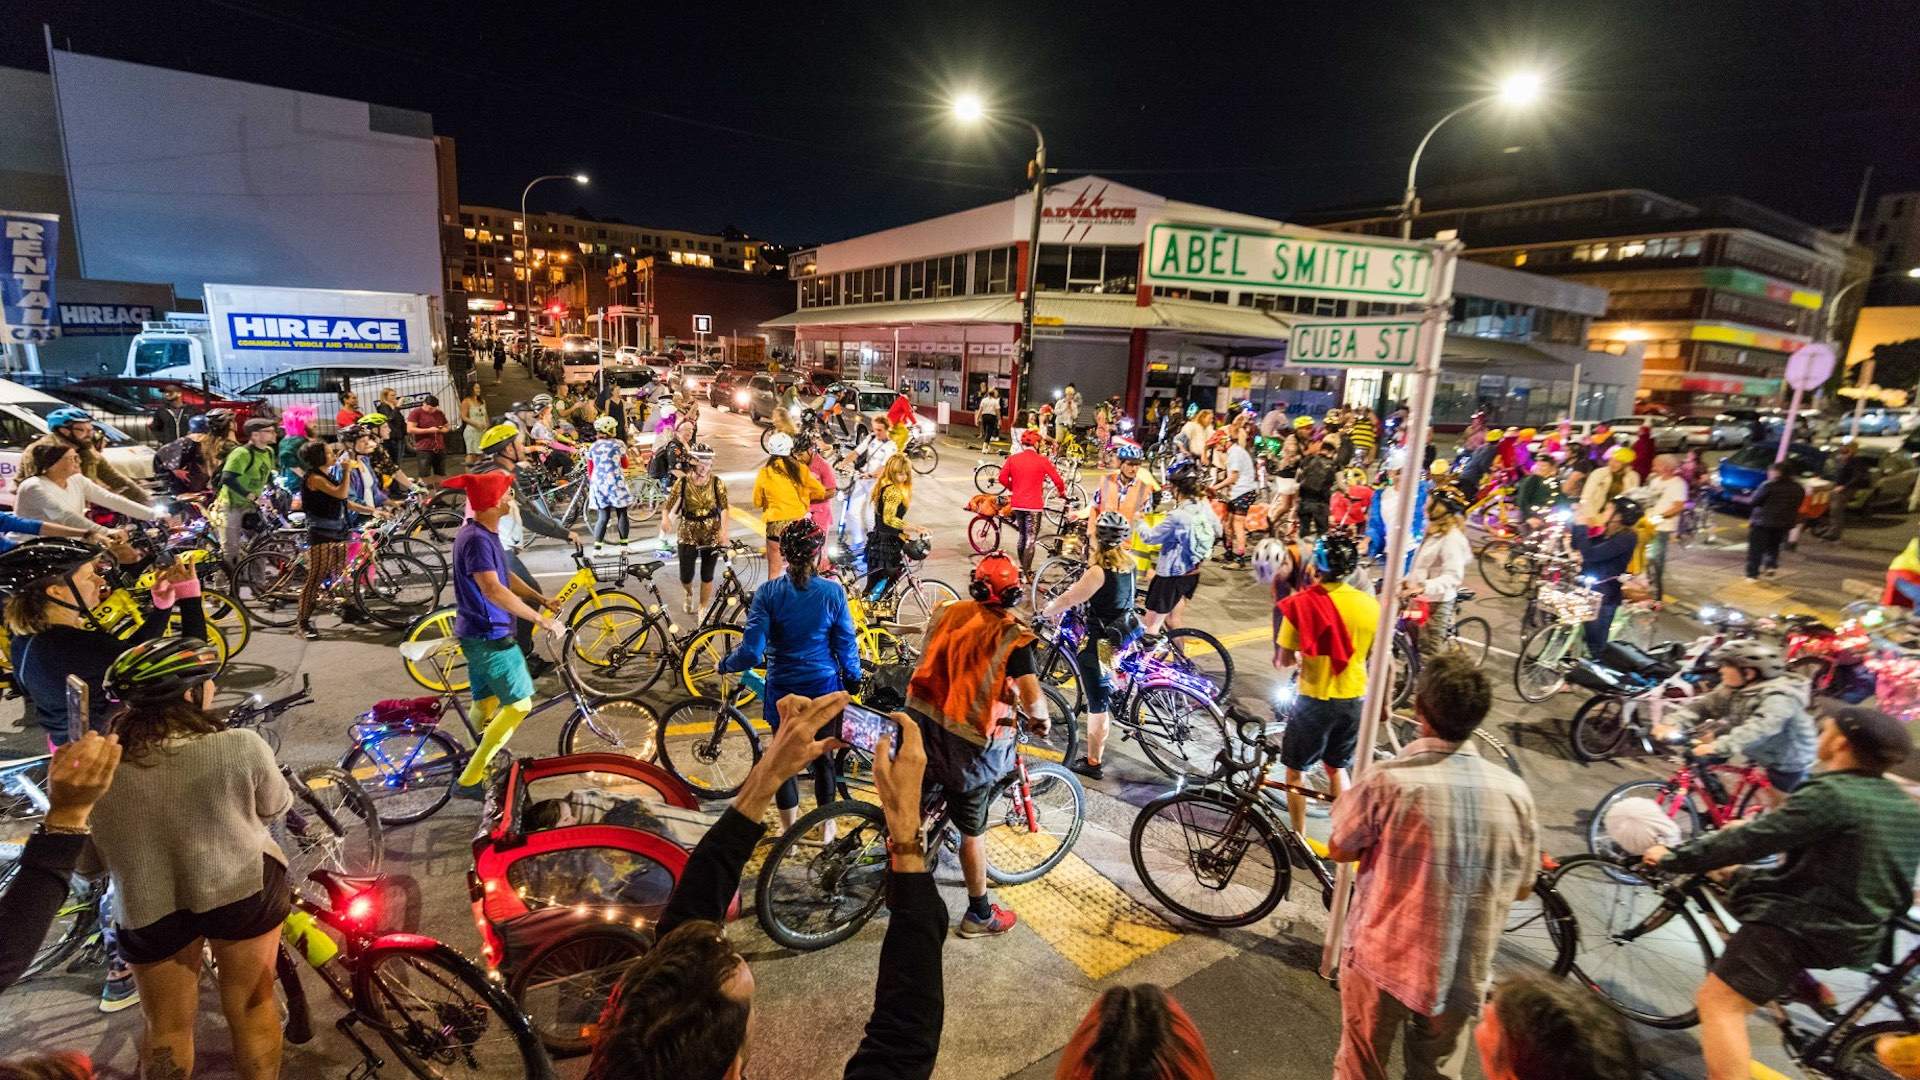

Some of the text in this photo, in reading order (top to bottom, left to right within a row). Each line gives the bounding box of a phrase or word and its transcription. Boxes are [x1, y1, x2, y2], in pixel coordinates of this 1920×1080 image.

[1041, 207, 1137, 219] ADVANCE
[6, 220, 50, 325] RENTAL
[1160, 233, 1424, 290] ABEL SMITH ST
[60, 305, 153, 324] HIREACE
[233, 316, 401, 341] HIREACE
[238, 339, 291, 348] COMMERCIAL
[294, 341, 324, 349] VEHICLE
[344, 342, 373, 350] TRAILER
[1298, 328, 1409, 360] CUBA ST
